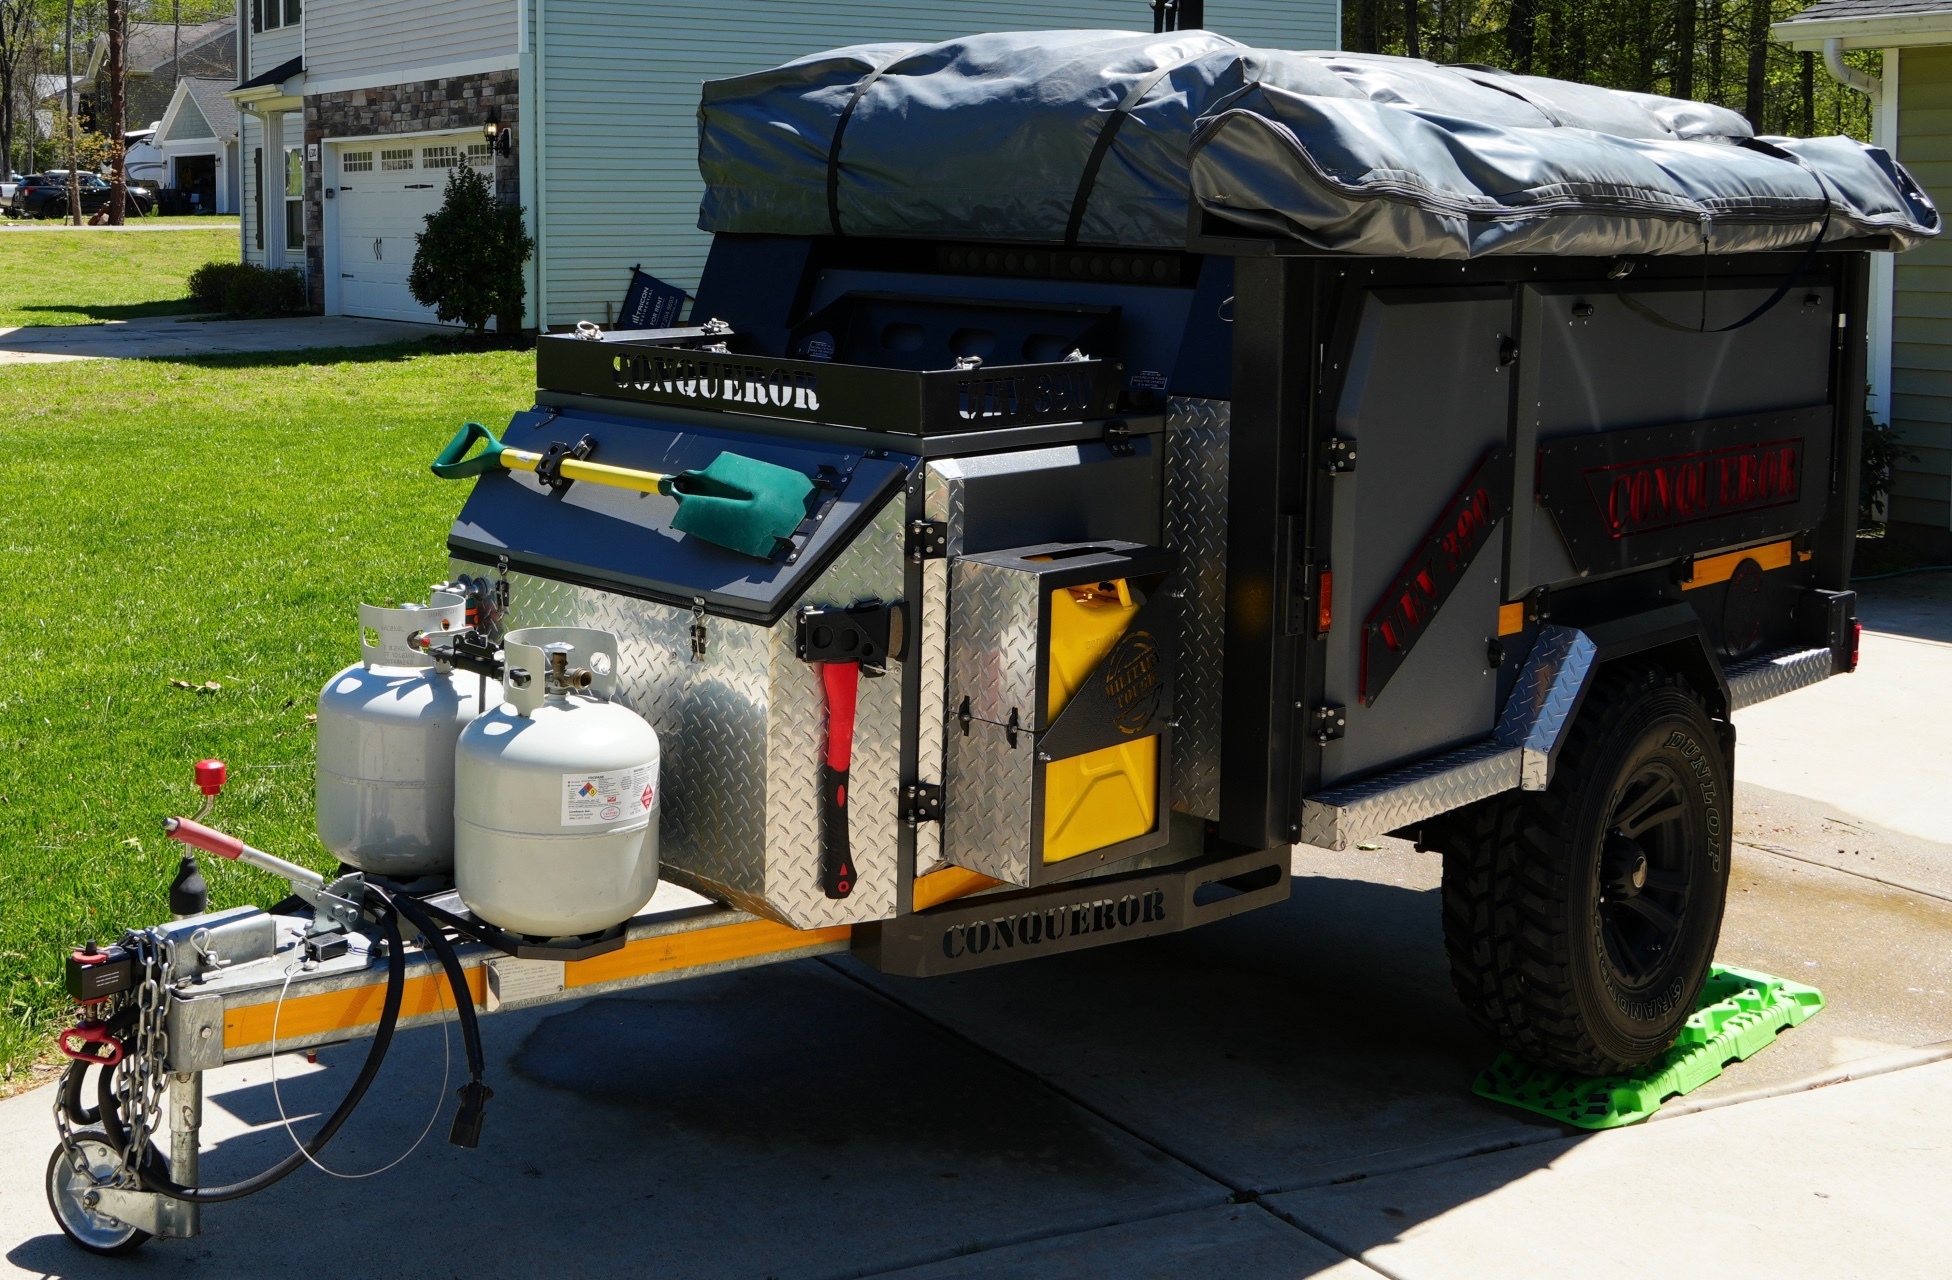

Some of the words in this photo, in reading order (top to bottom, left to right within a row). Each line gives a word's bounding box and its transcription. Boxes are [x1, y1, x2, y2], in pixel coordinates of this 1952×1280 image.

[636, 287, 649, 315] TRICON
[640, 289, 653, 325] RESIDENTIAL
[650, 312, 658, 326] FOR
[654, 296, 663, 313] RENT
[612, 352, 819, 411] CONQUEROR
[1034, 372, 1093, 413] 390
[1608, 448, 1797, 529] CONQUEROR
[1442, 487, 1491, 572] 390
[1663, 731, 1722, 873] DUNLOP
[942, 888, 1167, 959] CONQUEROR
